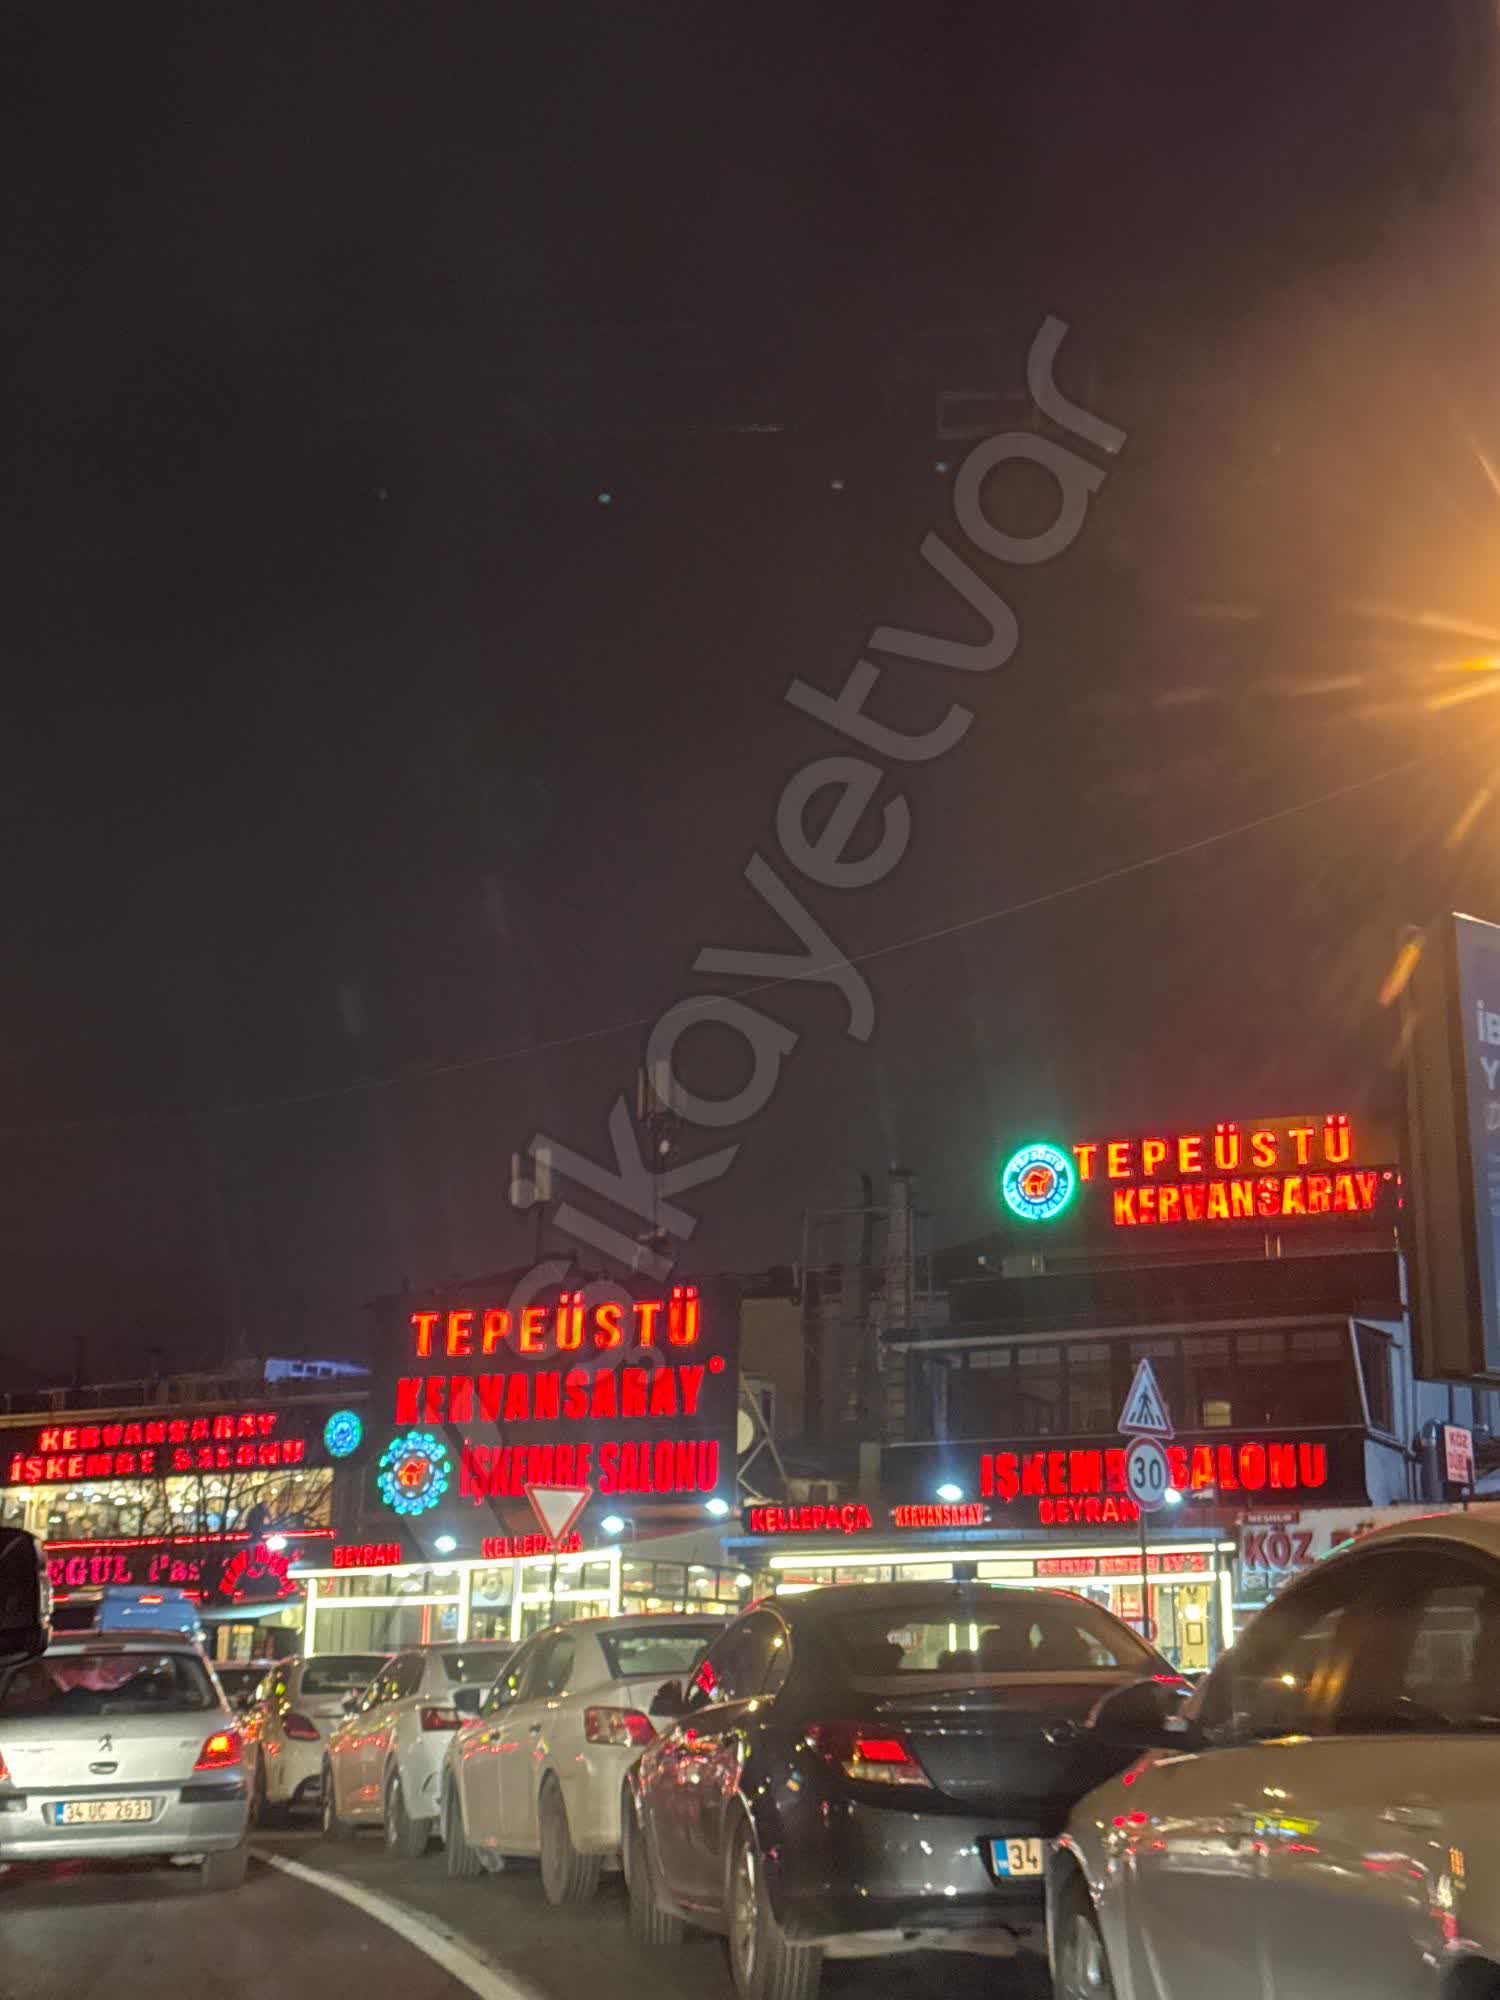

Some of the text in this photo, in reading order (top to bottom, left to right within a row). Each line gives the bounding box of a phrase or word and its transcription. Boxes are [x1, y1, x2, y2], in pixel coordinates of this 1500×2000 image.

[1072, 1114, 1352, 1182] TEPEÜSTÜ
[1112, 1171, 1377, 1226] KERVANSARAY
[411, 1286, 699, 1358] TEPEÜSTÜ
[395, 1365, 705, 1425] KERVANSARAY
[599, 1440, 719, 1494] SALONU
[1134, 1456, 1162, 1490] 30
[1166, 1443, 1326, 1490] SALONU
[750, 1503, 872, 1535] KELLEPAÇA
[1244, 1524, 1314, 1570] KÖZ
[1009, 1843, 1037, 1869] 34
